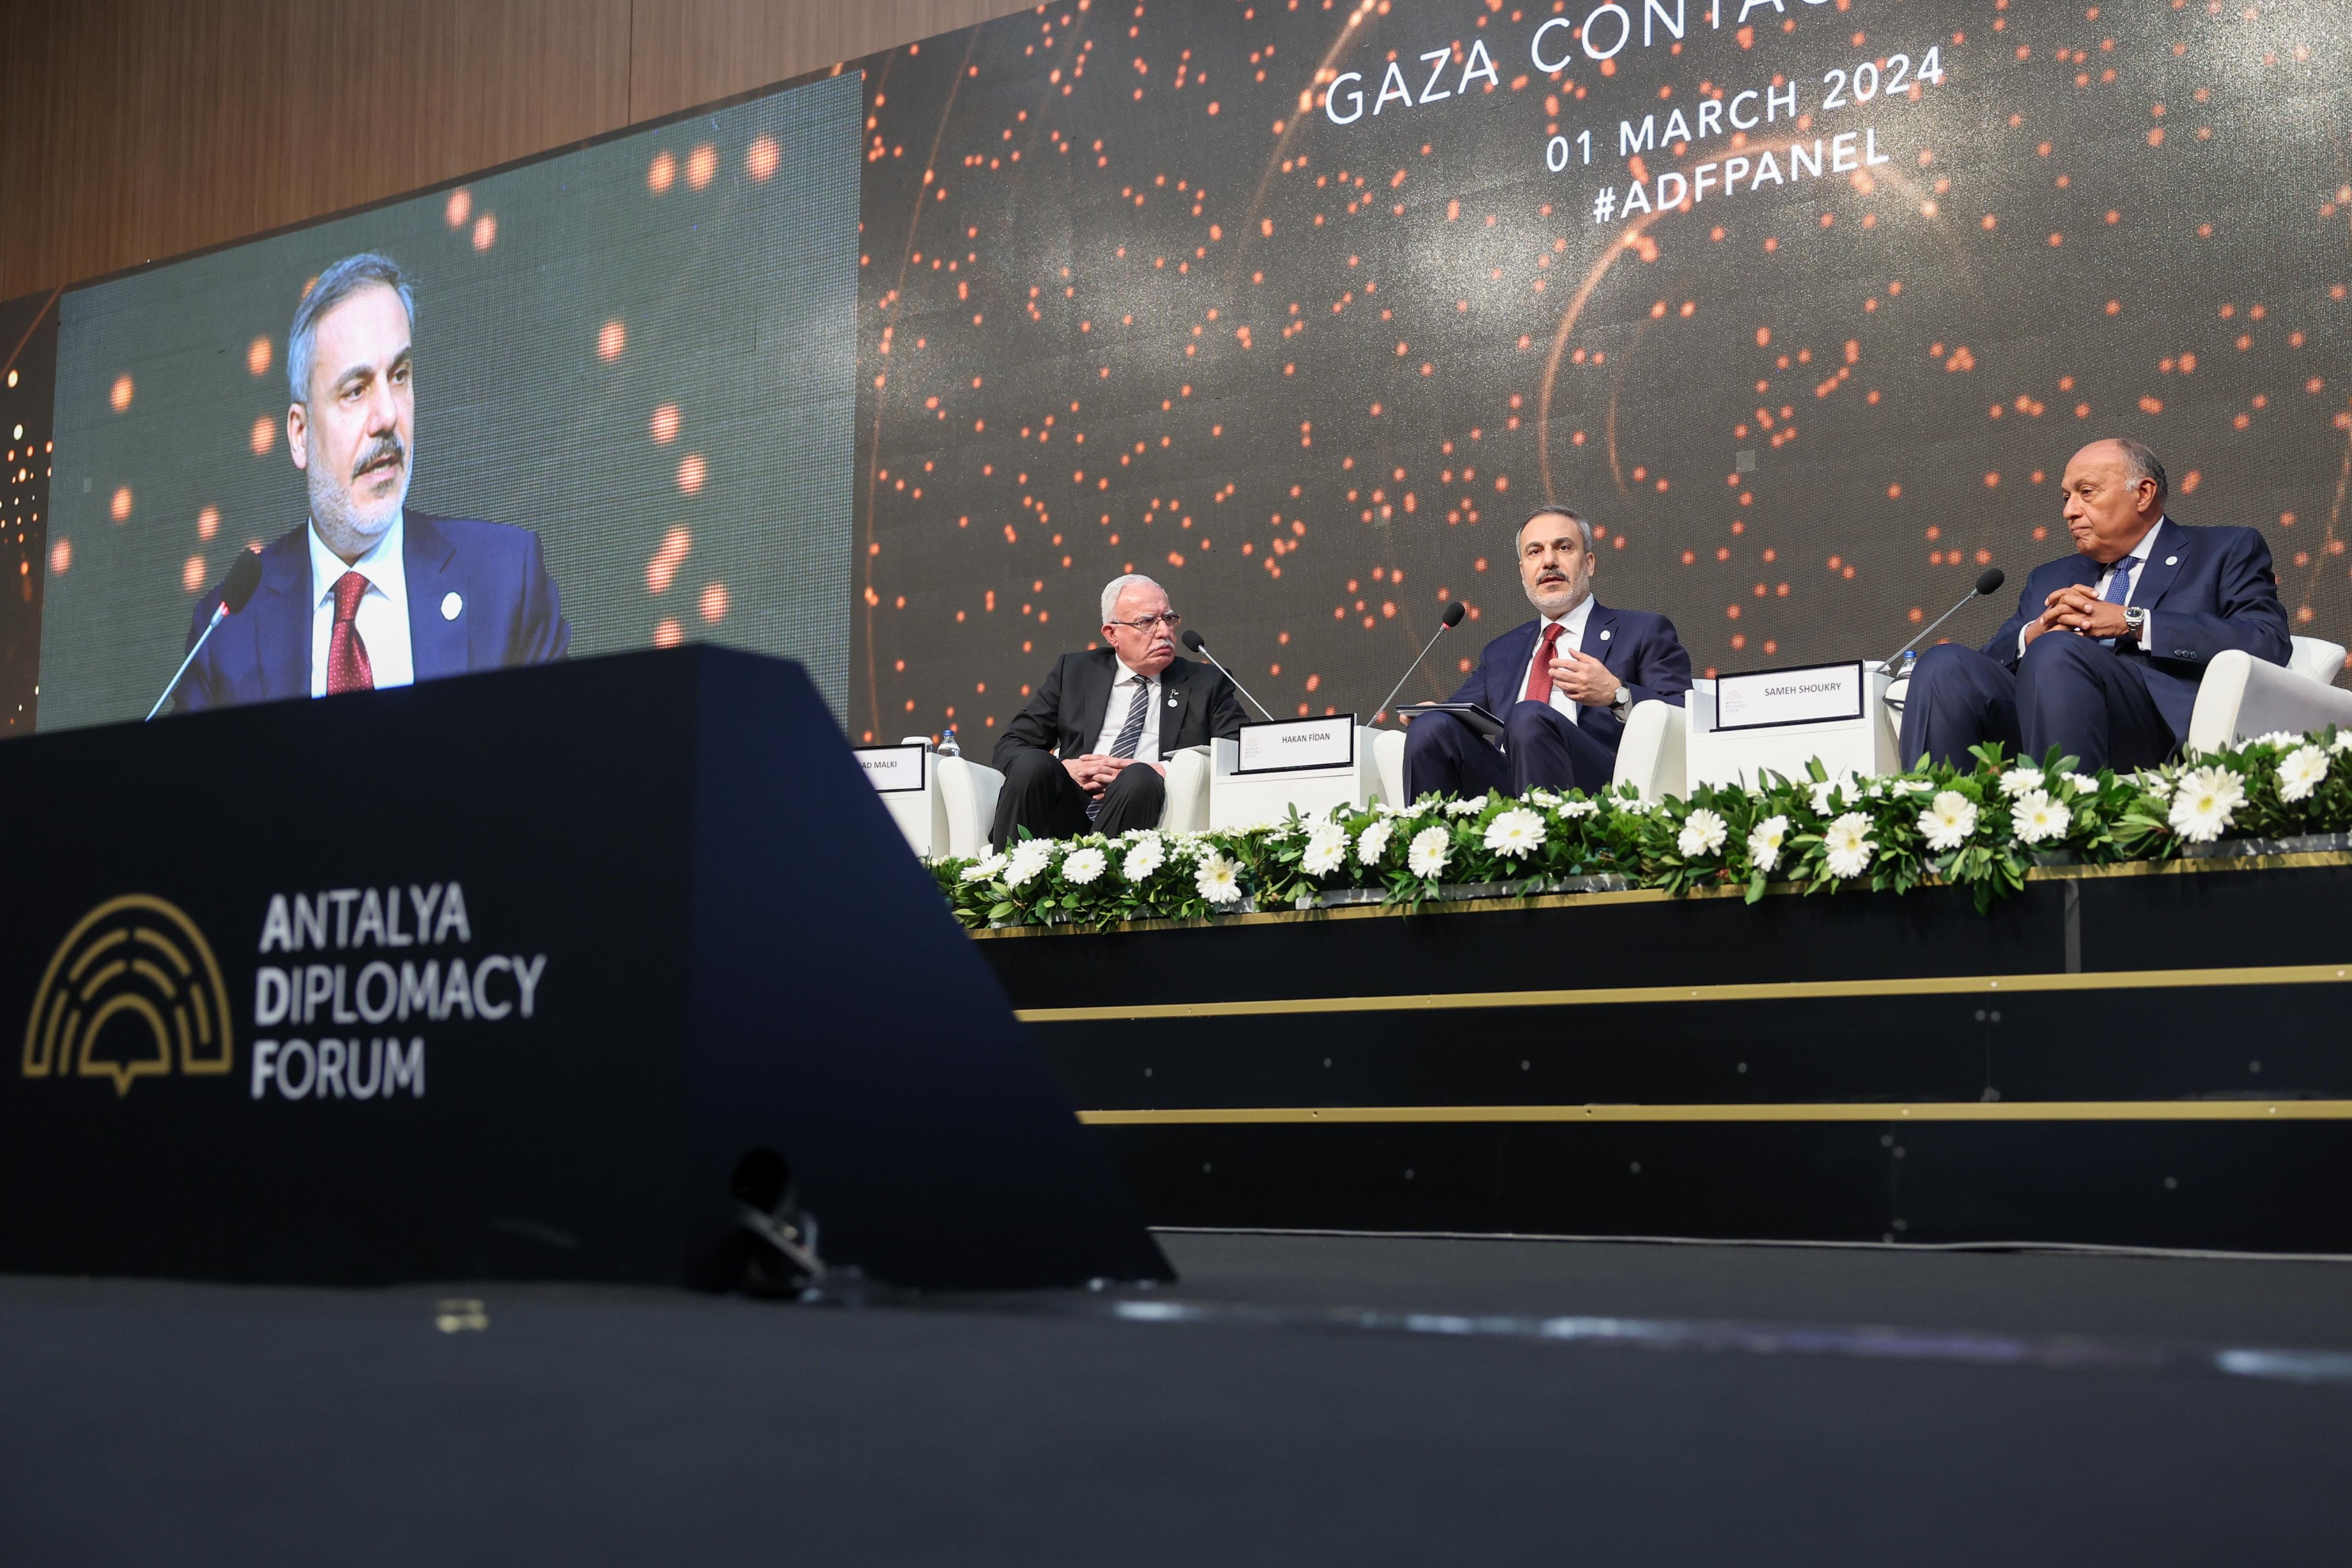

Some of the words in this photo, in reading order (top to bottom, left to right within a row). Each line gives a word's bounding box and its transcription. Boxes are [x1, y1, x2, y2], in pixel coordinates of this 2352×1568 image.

[1325, 40, 1499, 125] GAZA
[1531, 0, 1822, 73] CONT
[1546, 130, 1590, 172] 01
[1620, 80, 1797, 156] MARCH
[1821, 46, 1944, 110] 2024
[1592, 127, 1890, 224] #ADFPANEL
[1765, 686, 1797, 696] SAMEH
[1799, 682, 1842, 694] SHOUKRY
[874, 761, 897, 769] MALKI
[1282, 735, 1307, 744] HAKAN
[1309, 732, 1330, 741] FİDAN
[259, 881, 471, 953] ANTALYA
[255, 954, 547, 1026] DIPLOMACY
[251, 1037, 425, 1099] FORUM
